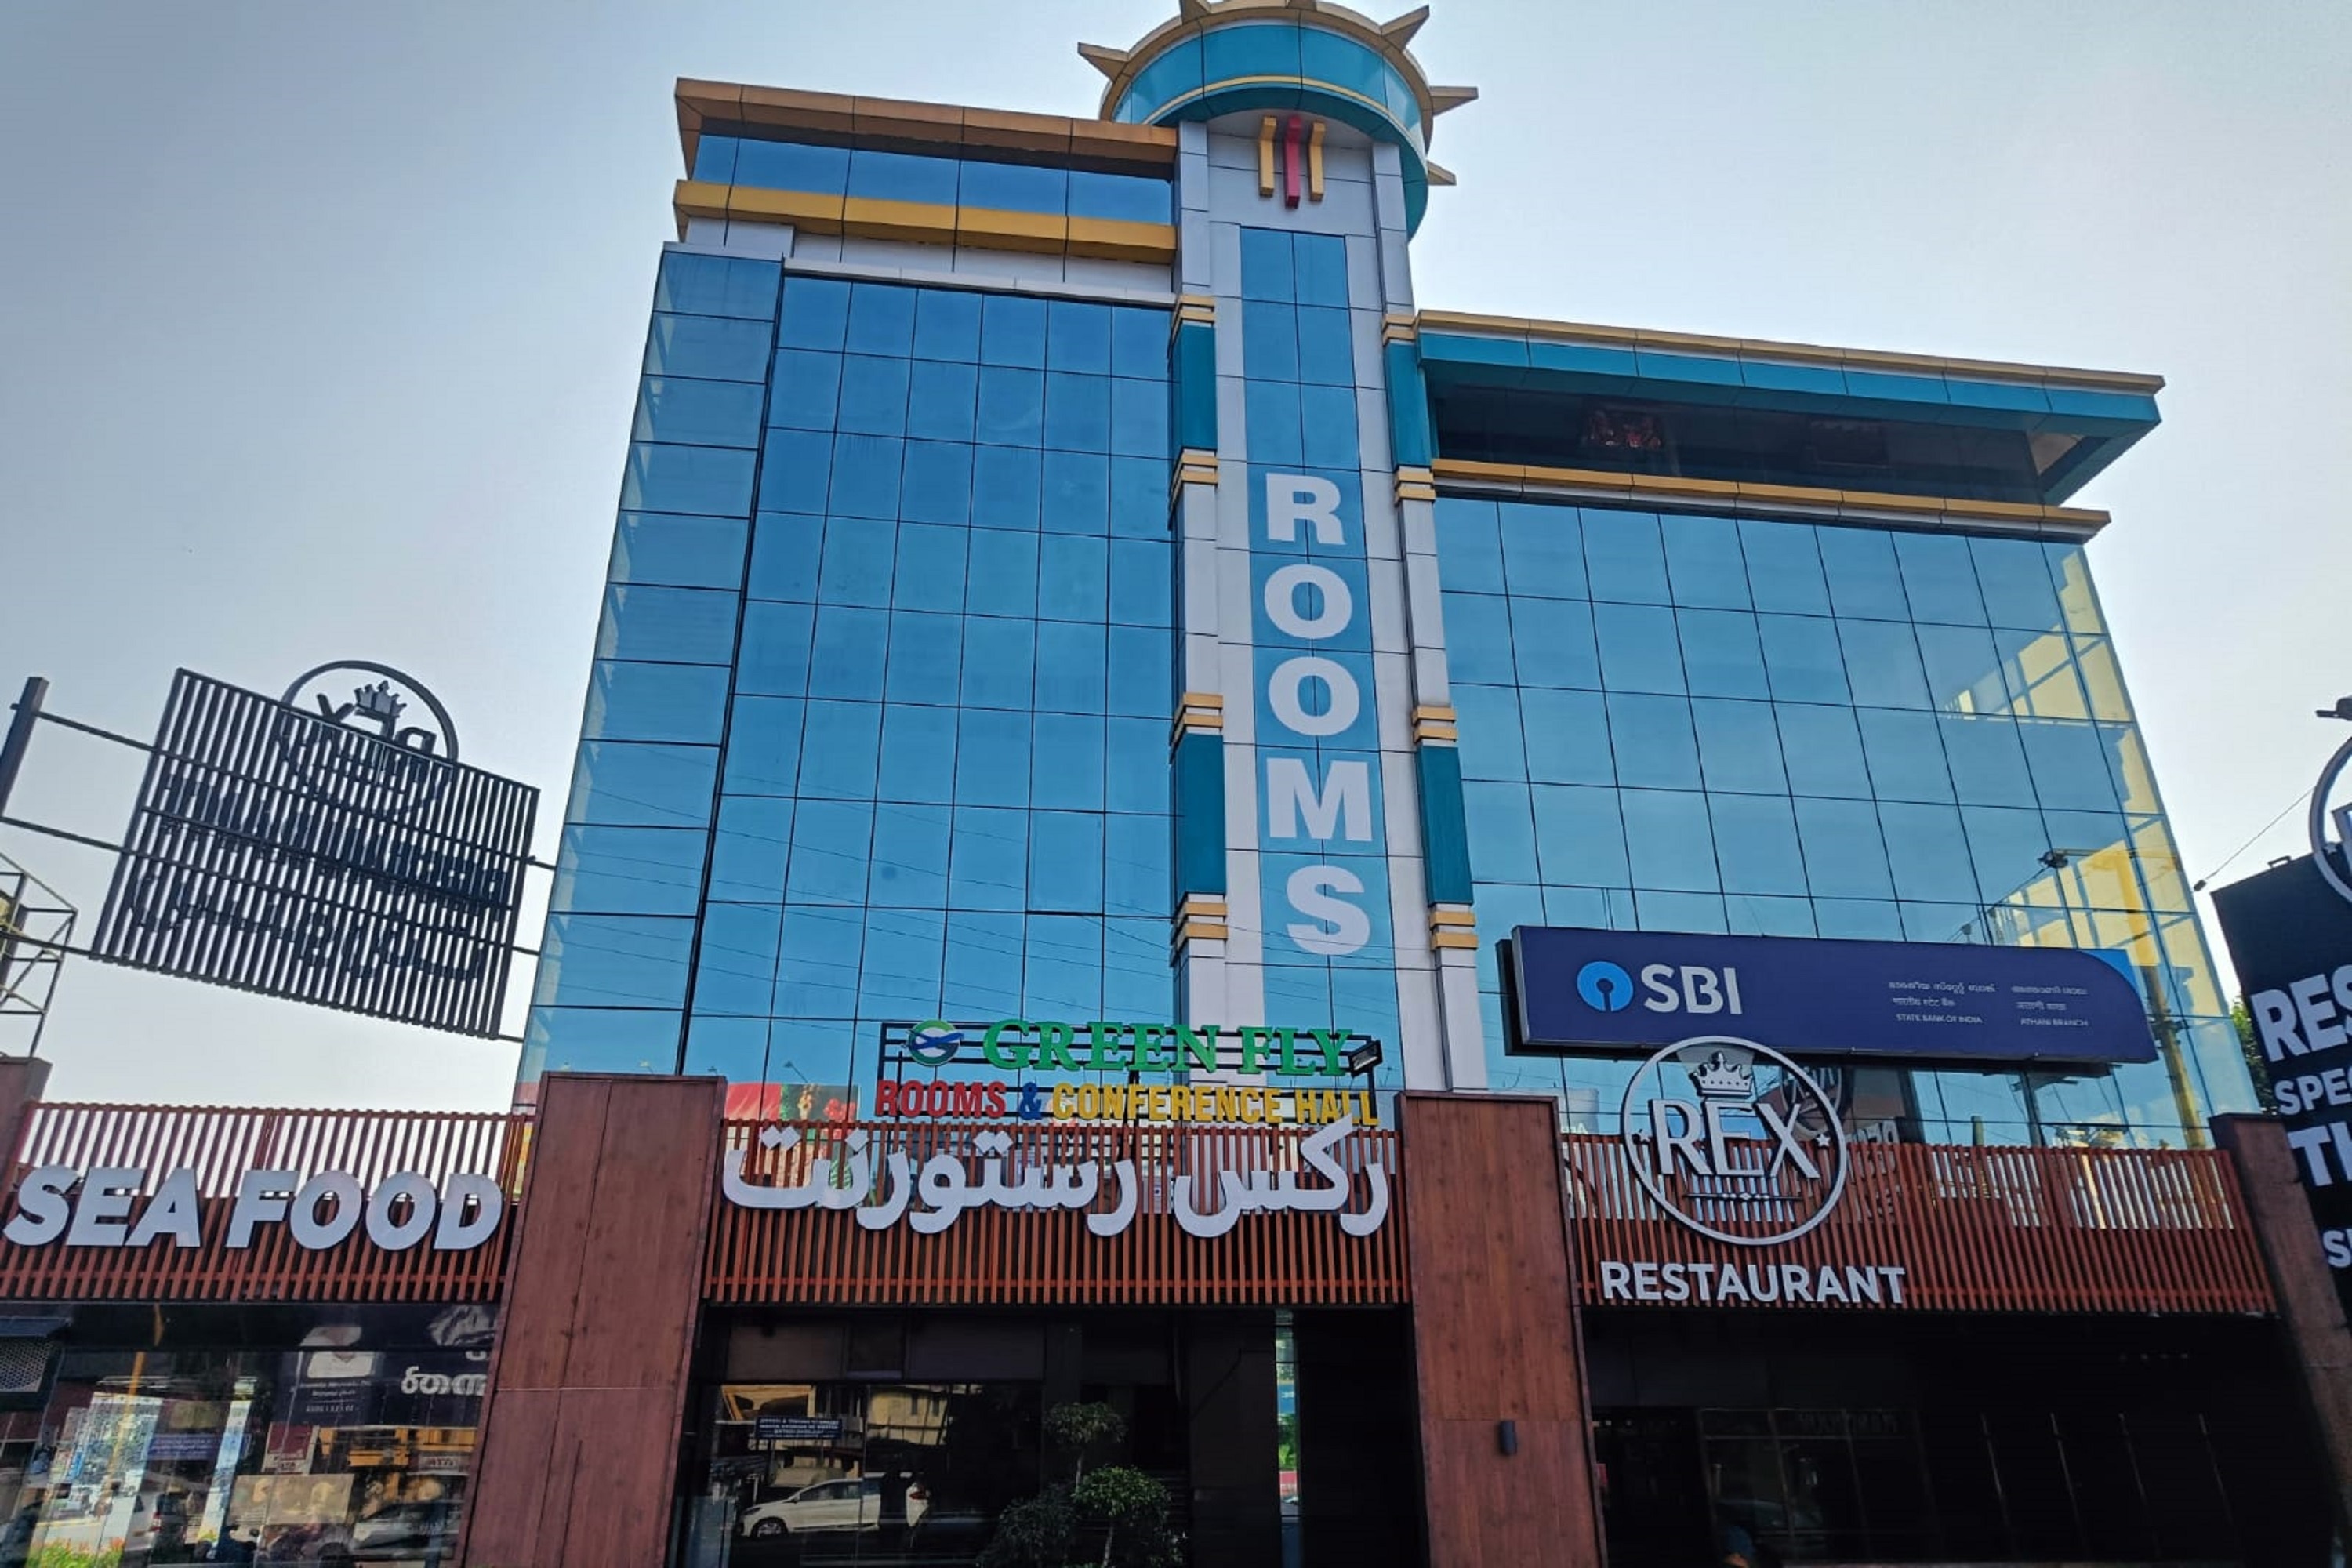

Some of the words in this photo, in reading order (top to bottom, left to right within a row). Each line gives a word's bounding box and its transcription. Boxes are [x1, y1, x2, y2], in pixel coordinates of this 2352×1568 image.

[1263, 472, 1372, 956] ROOMS
[1641, 964, 1742, 1014] SBI
[1896, 1013, 1920, 1022] STATE
[1921, 1014, 1945, 1022] BANK
[1958, 1015, 1984, 1024] INDIA
[983, 1018, 1221, 1073] GREEN
[1237, 1025, 1353, 1077] FLY
[875, 1080, 1007, 1120] ROOMS
[1020, 1080, 1043, 1120] &
[1052, 1082, 1283, 1124] CONFERENCE
[1296, 1088, 1380, 1127] HALL
[2275, 1066, 2352, 1115] SPE
[1648, 1096, 1821, 1179] REX
[2, 1165, 201, 1248] SEA
[225, 1169, 503, 1251] FOOD
[2323, 1229, 2352, 1268] S
[1600, 1261, 1906, 1304] RESTAURANT
